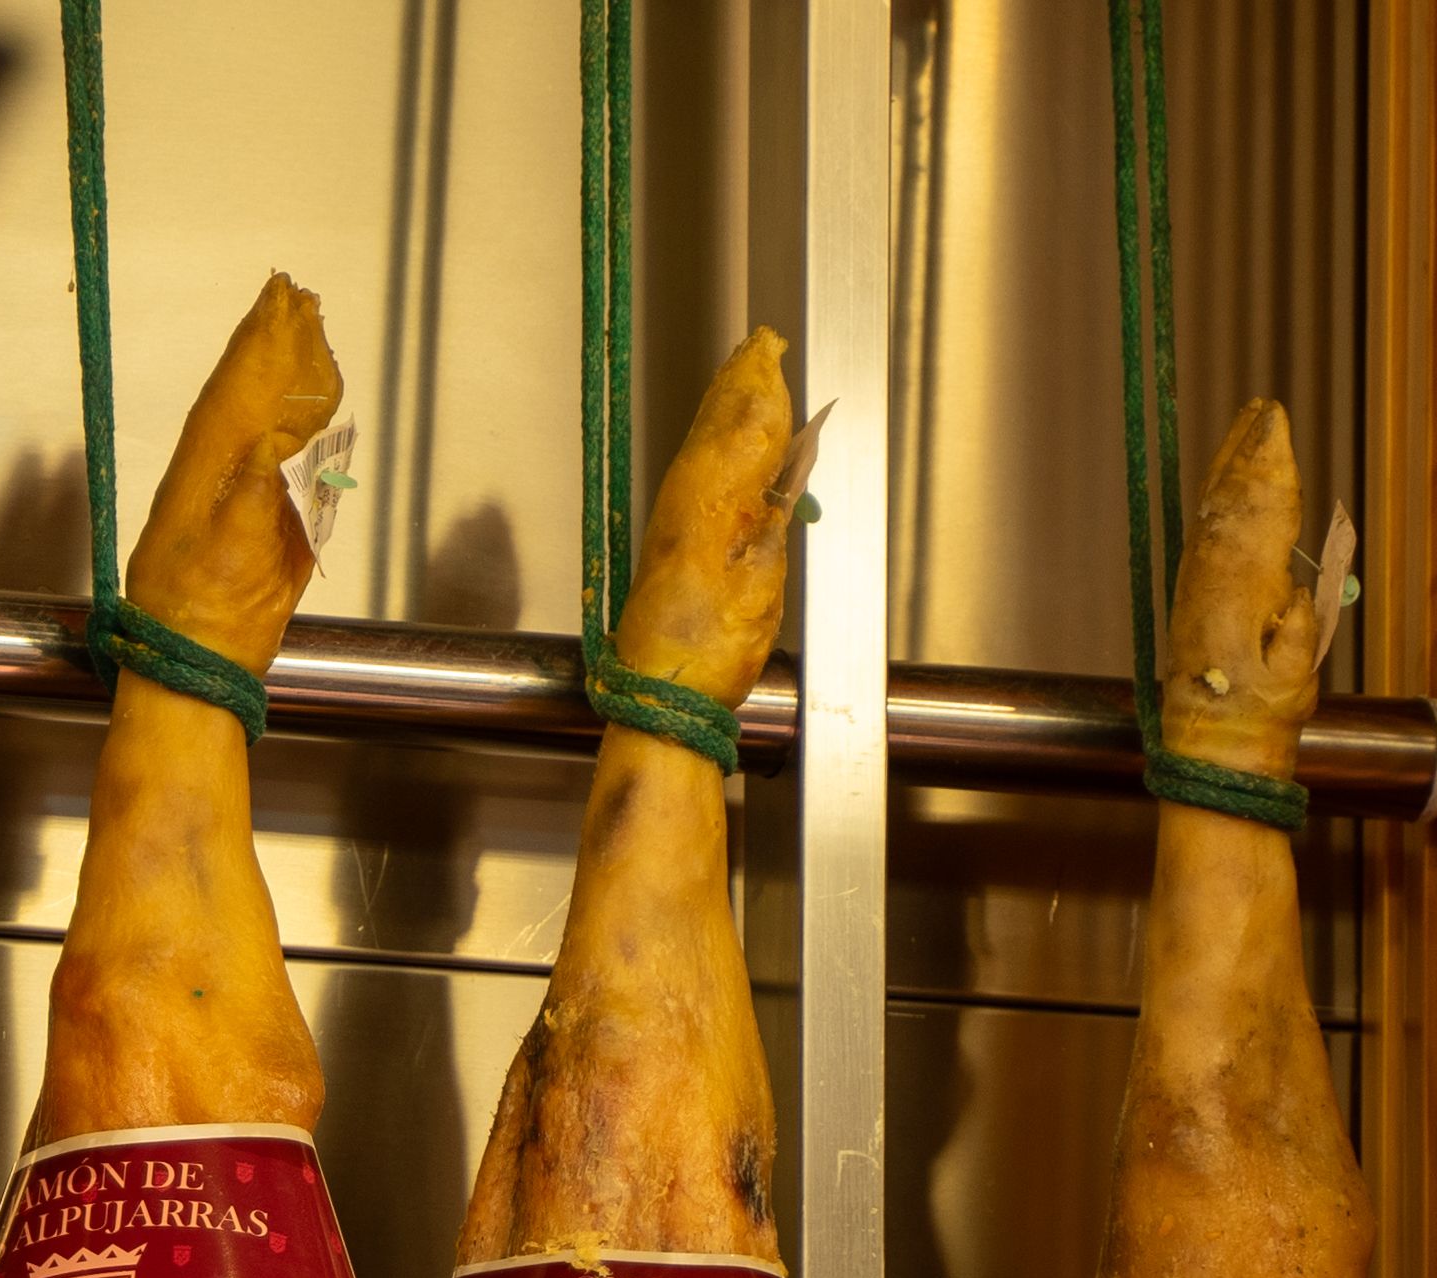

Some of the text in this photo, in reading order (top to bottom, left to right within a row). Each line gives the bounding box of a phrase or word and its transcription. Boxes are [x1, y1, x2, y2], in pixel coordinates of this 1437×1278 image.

[19, 1157, 205, 1211] AMÓN DE
[11, 1198, 270, 1253] ALPUJARRAS
